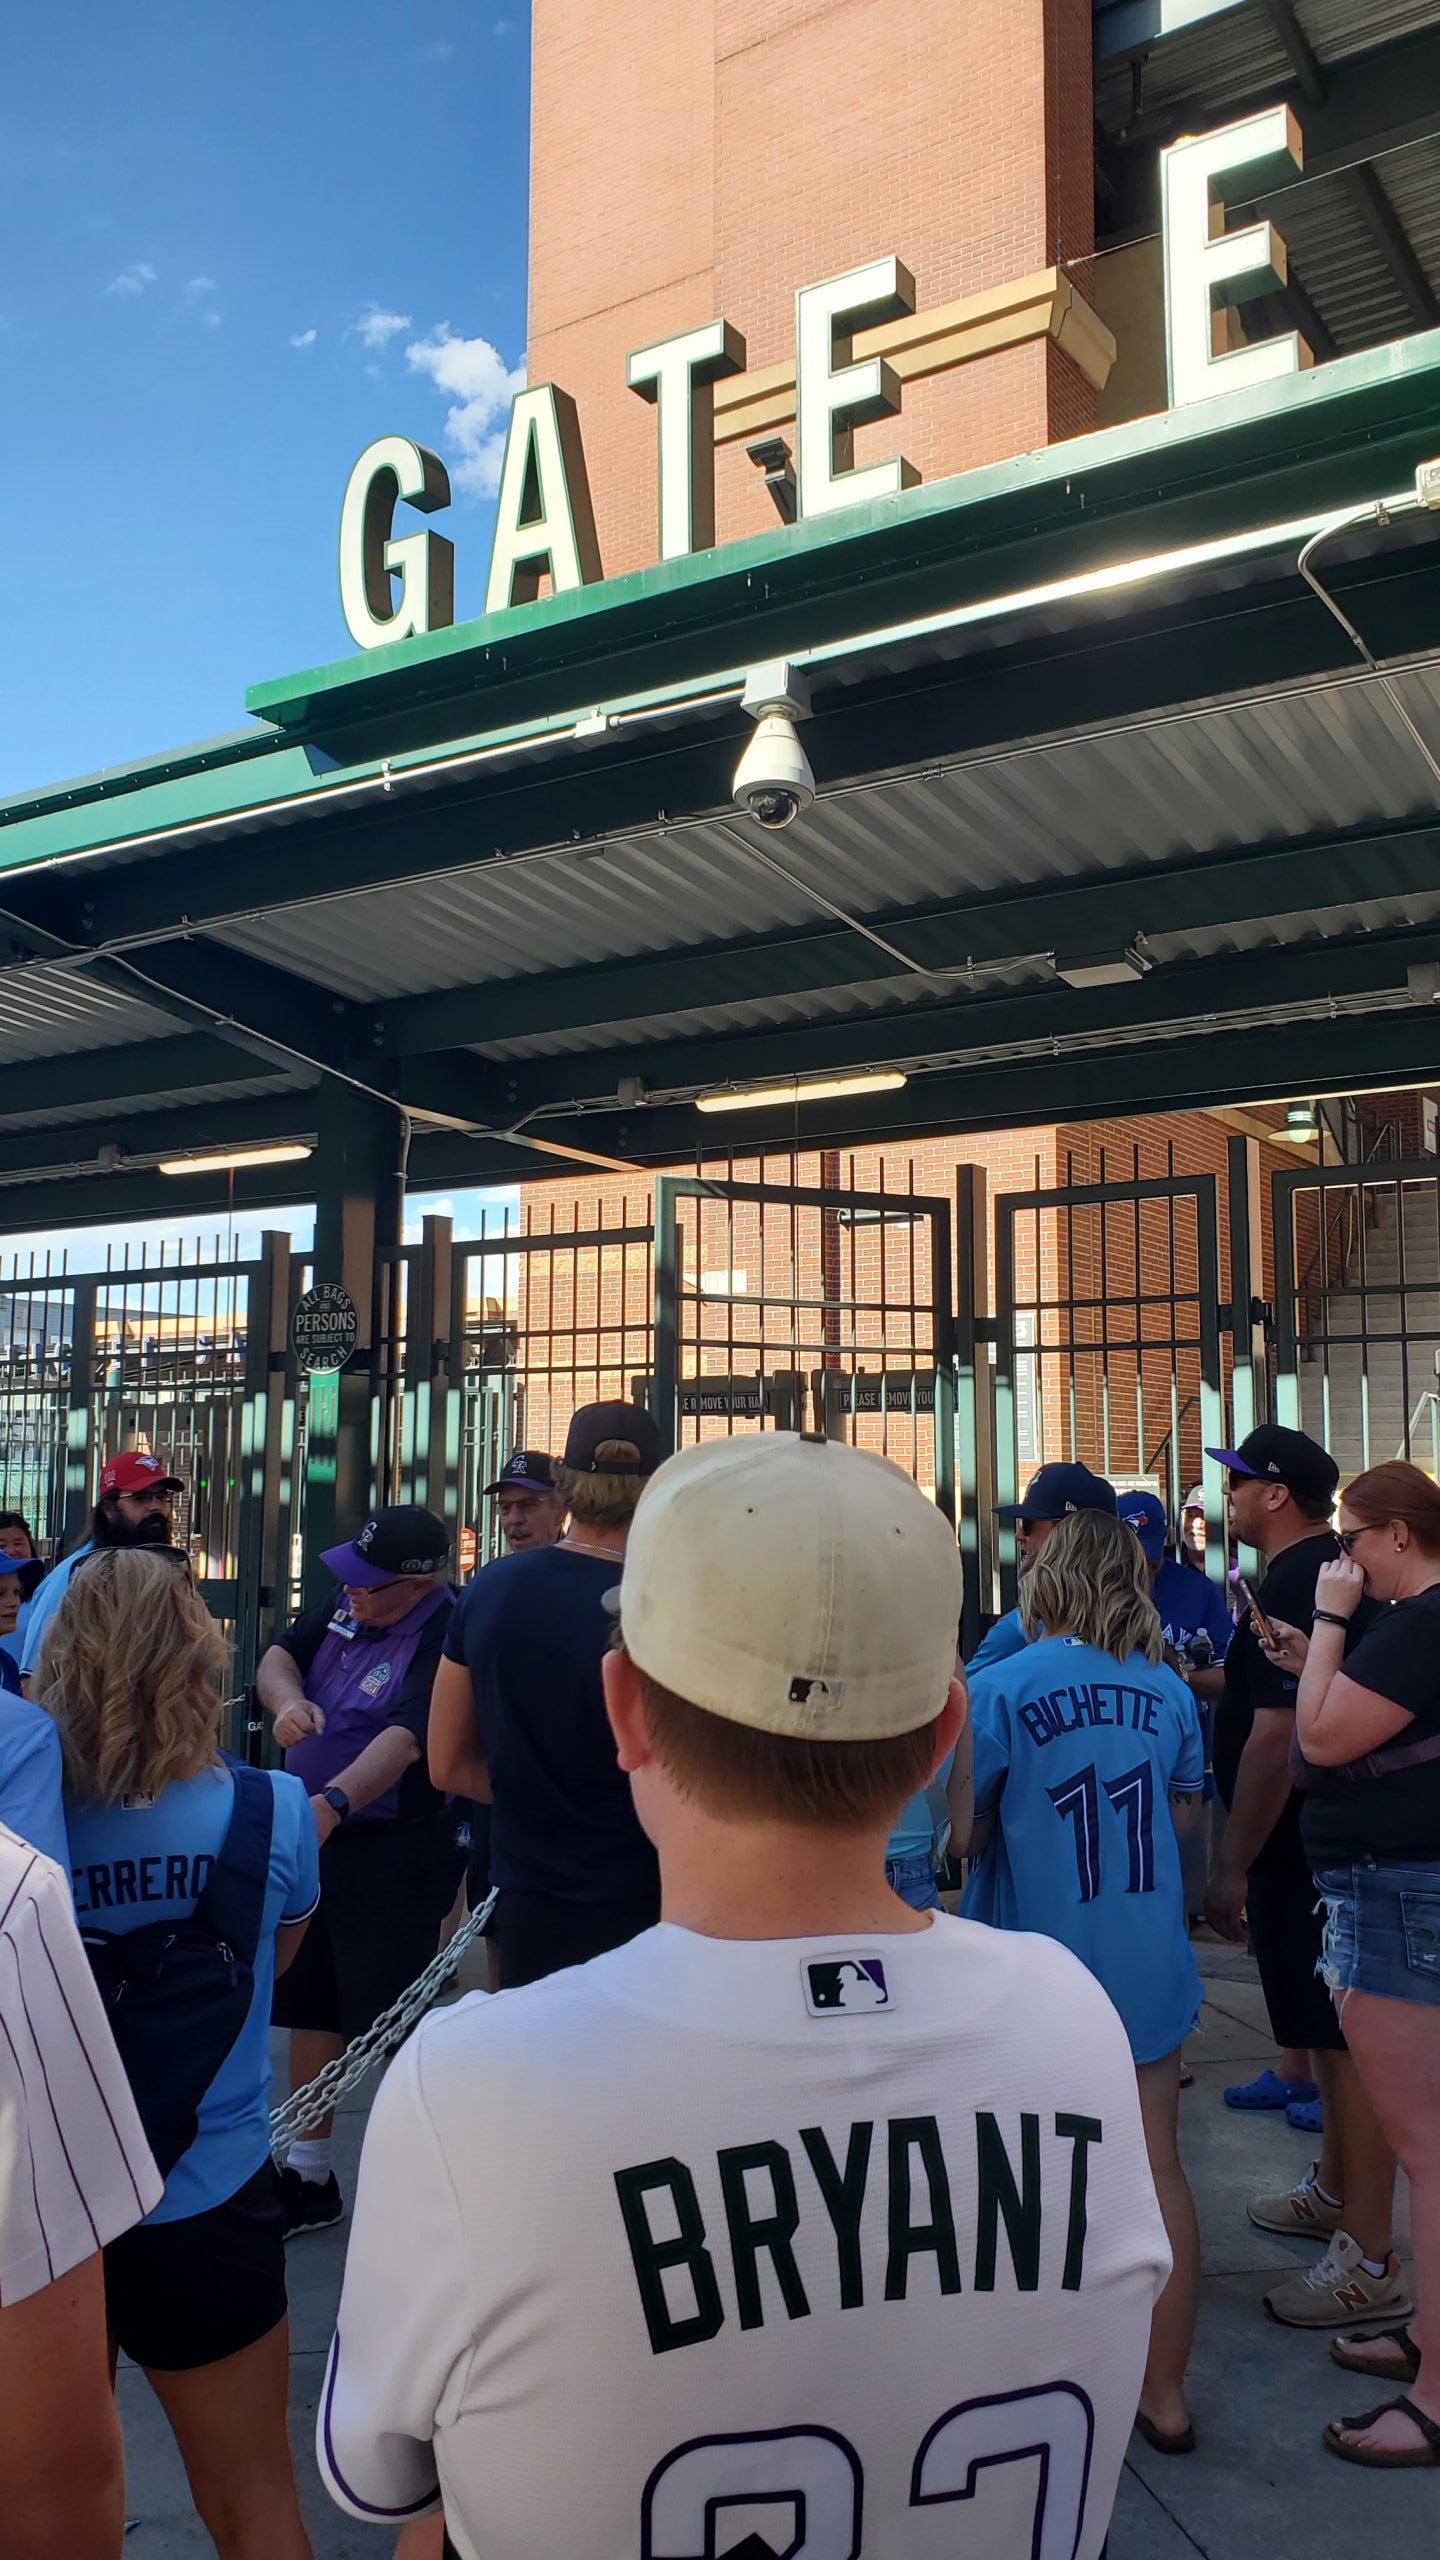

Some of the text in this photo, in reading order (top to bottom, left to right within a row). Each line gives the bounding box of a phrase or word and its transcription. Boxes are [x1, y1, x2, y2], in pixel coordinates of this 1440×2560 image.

[337, 103, 1313, 651] GATE E
[301, 1285, 351, 1311] ALL BAGS
[296, 1312, 356, 1332] PERSONS
[295, 1332, 355, 1344] ARE SUBJECT TO
[300, 1346, 348, 1370] SEARCH
[690, 1396, 723, 1410] RMOVE
[843, 1392, 876, 1407] PEASE
[1017, 1683, 1163, 1747] BICHETTE
[1044, 1759, 1155, 1904] 11
[613, 2111, 1102, 2355] BRYANT
